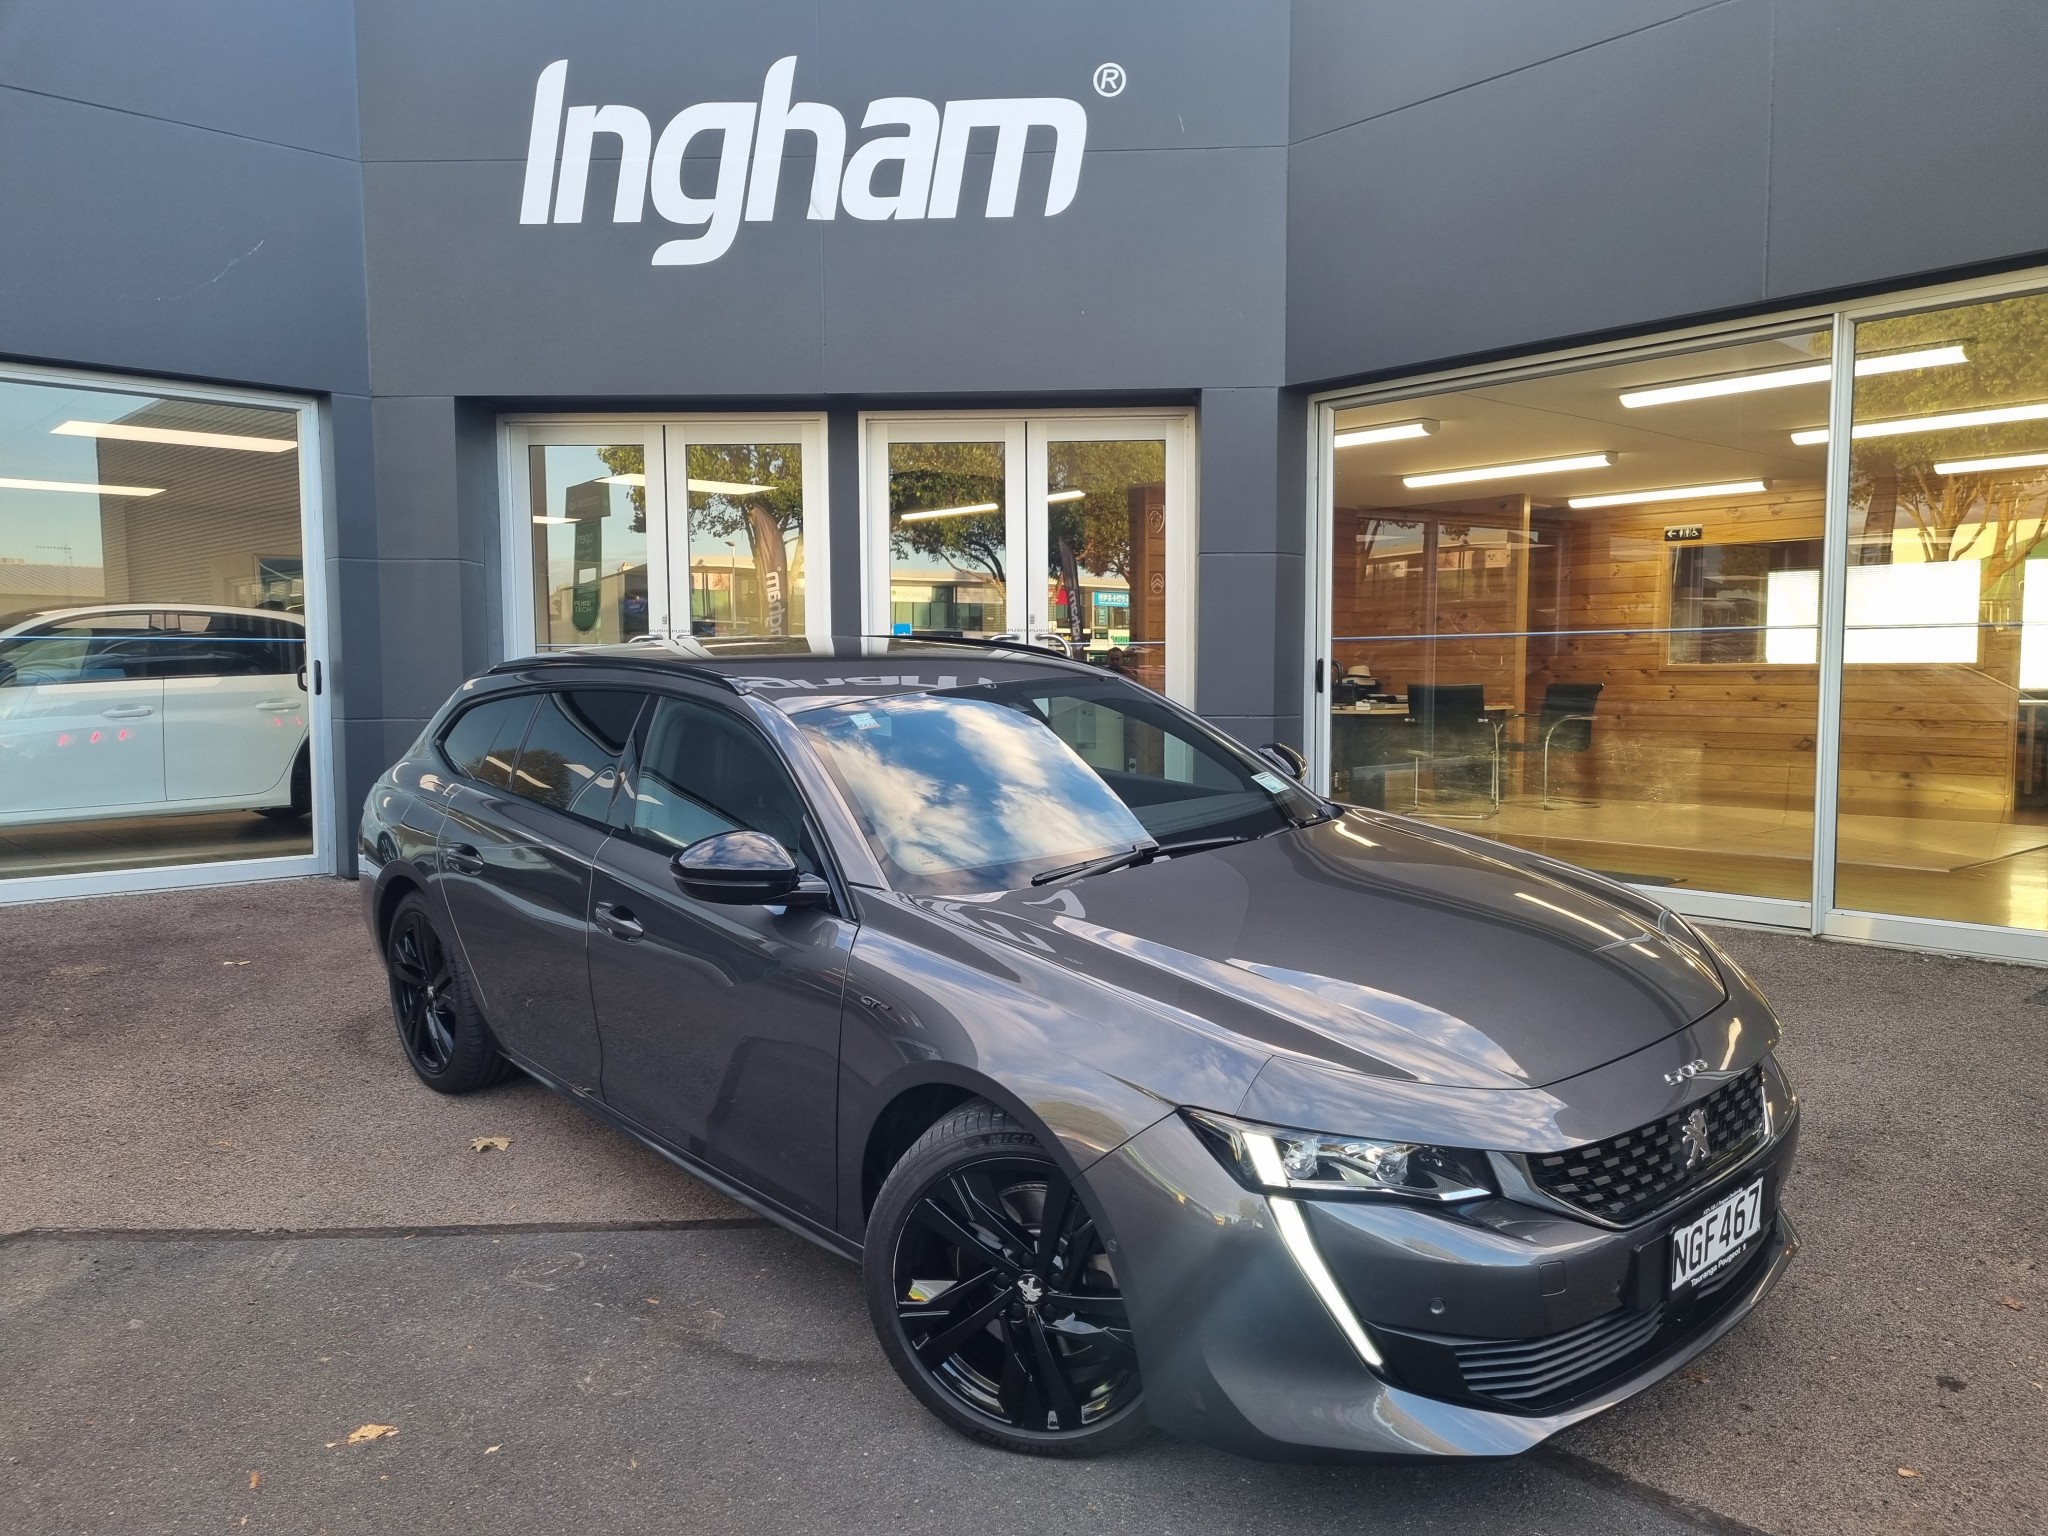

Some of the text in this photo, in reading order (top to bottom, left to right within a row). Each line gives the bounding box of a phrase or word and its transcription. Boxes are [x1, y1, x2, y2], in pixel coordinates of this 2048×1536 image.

[519, 55, 1088, 265] Ingham
[1664, 1059, 1709, 1086] 508
[988, 1134, 1034, 1144] MICH
[1672, 1184, 1760, 1284] NGF467
[1691, 1246, 1741, 1287] Tauranga Peugeot
